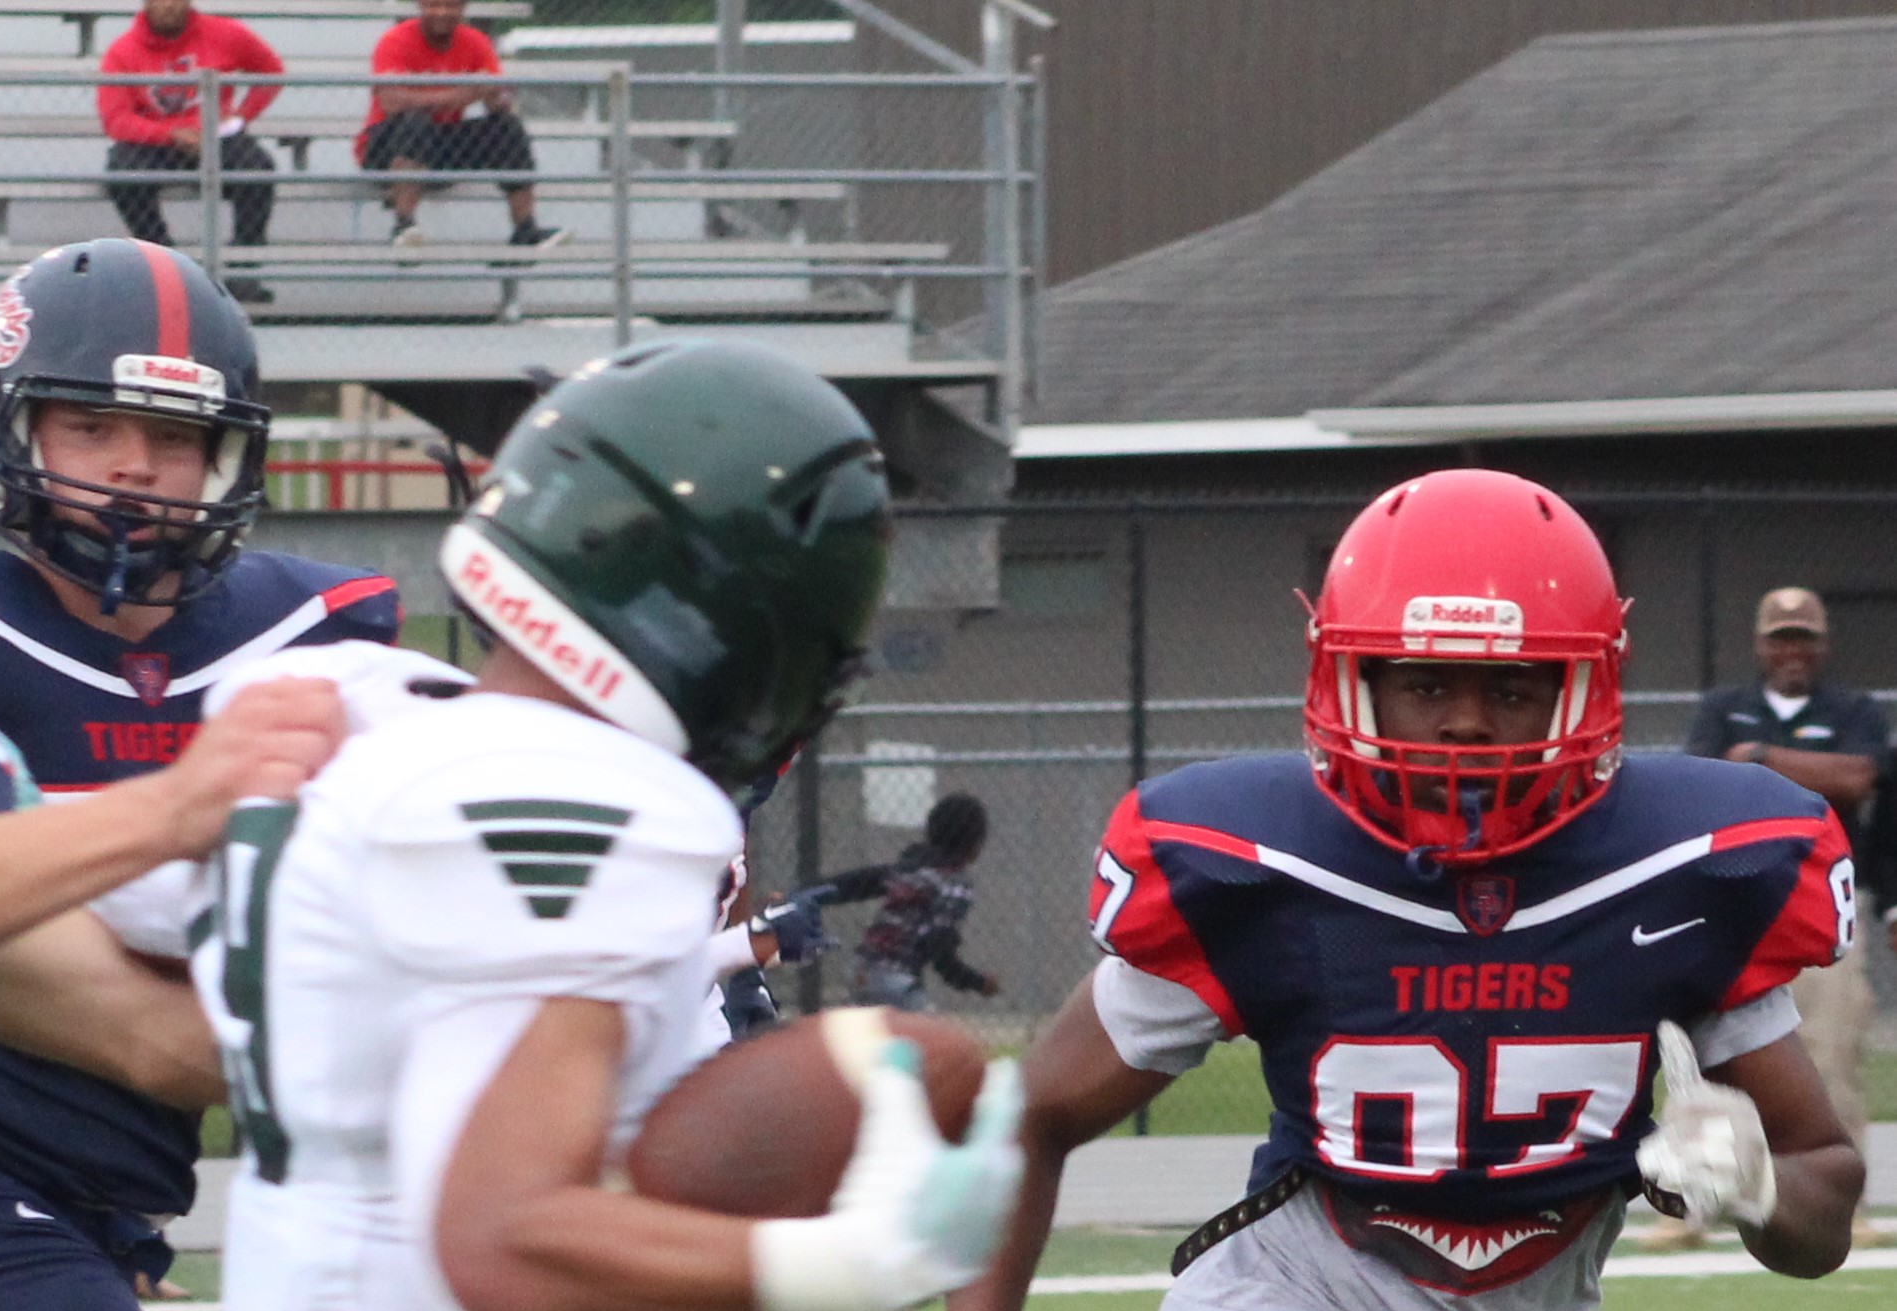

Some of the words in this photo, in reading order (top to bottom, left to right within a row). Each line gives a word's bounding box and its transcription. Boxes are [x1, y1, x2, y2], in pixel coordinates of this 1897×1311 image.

[144, 360, 199, 383] Riddell
[460, 551, 624, 701] Riddell
[1432, 603, 1495, 622] Riddell
[1390, 963, 1572, 1012] TIGERS
